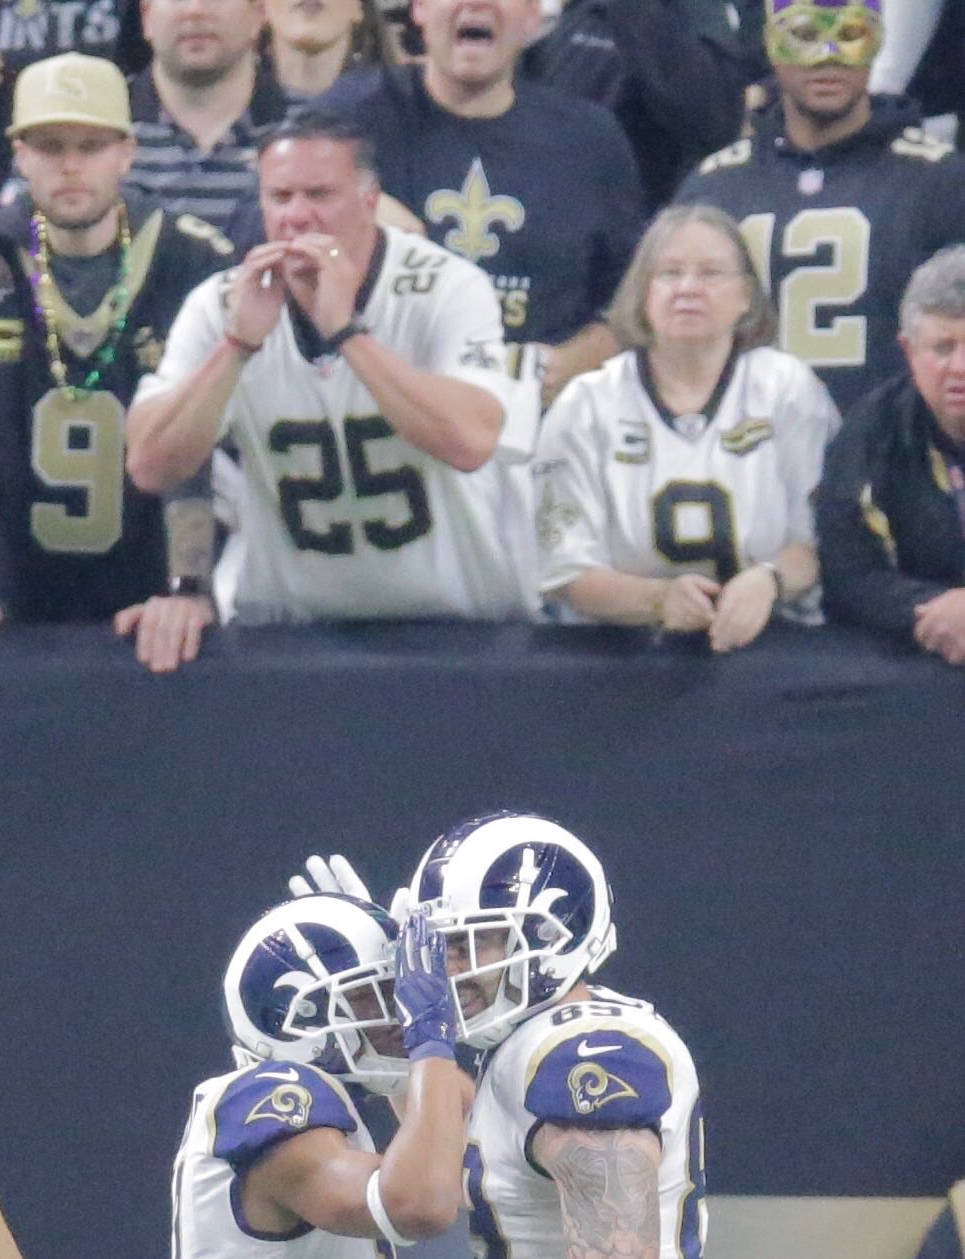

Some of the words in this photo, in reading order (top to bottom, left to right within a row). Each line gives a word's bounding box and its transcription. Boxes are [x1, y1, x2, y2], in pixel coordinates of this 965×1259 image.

[31, 387, 127, 554] 9
[269, 416, 432, 556] 25
[651, 478, 740, 584] 9
